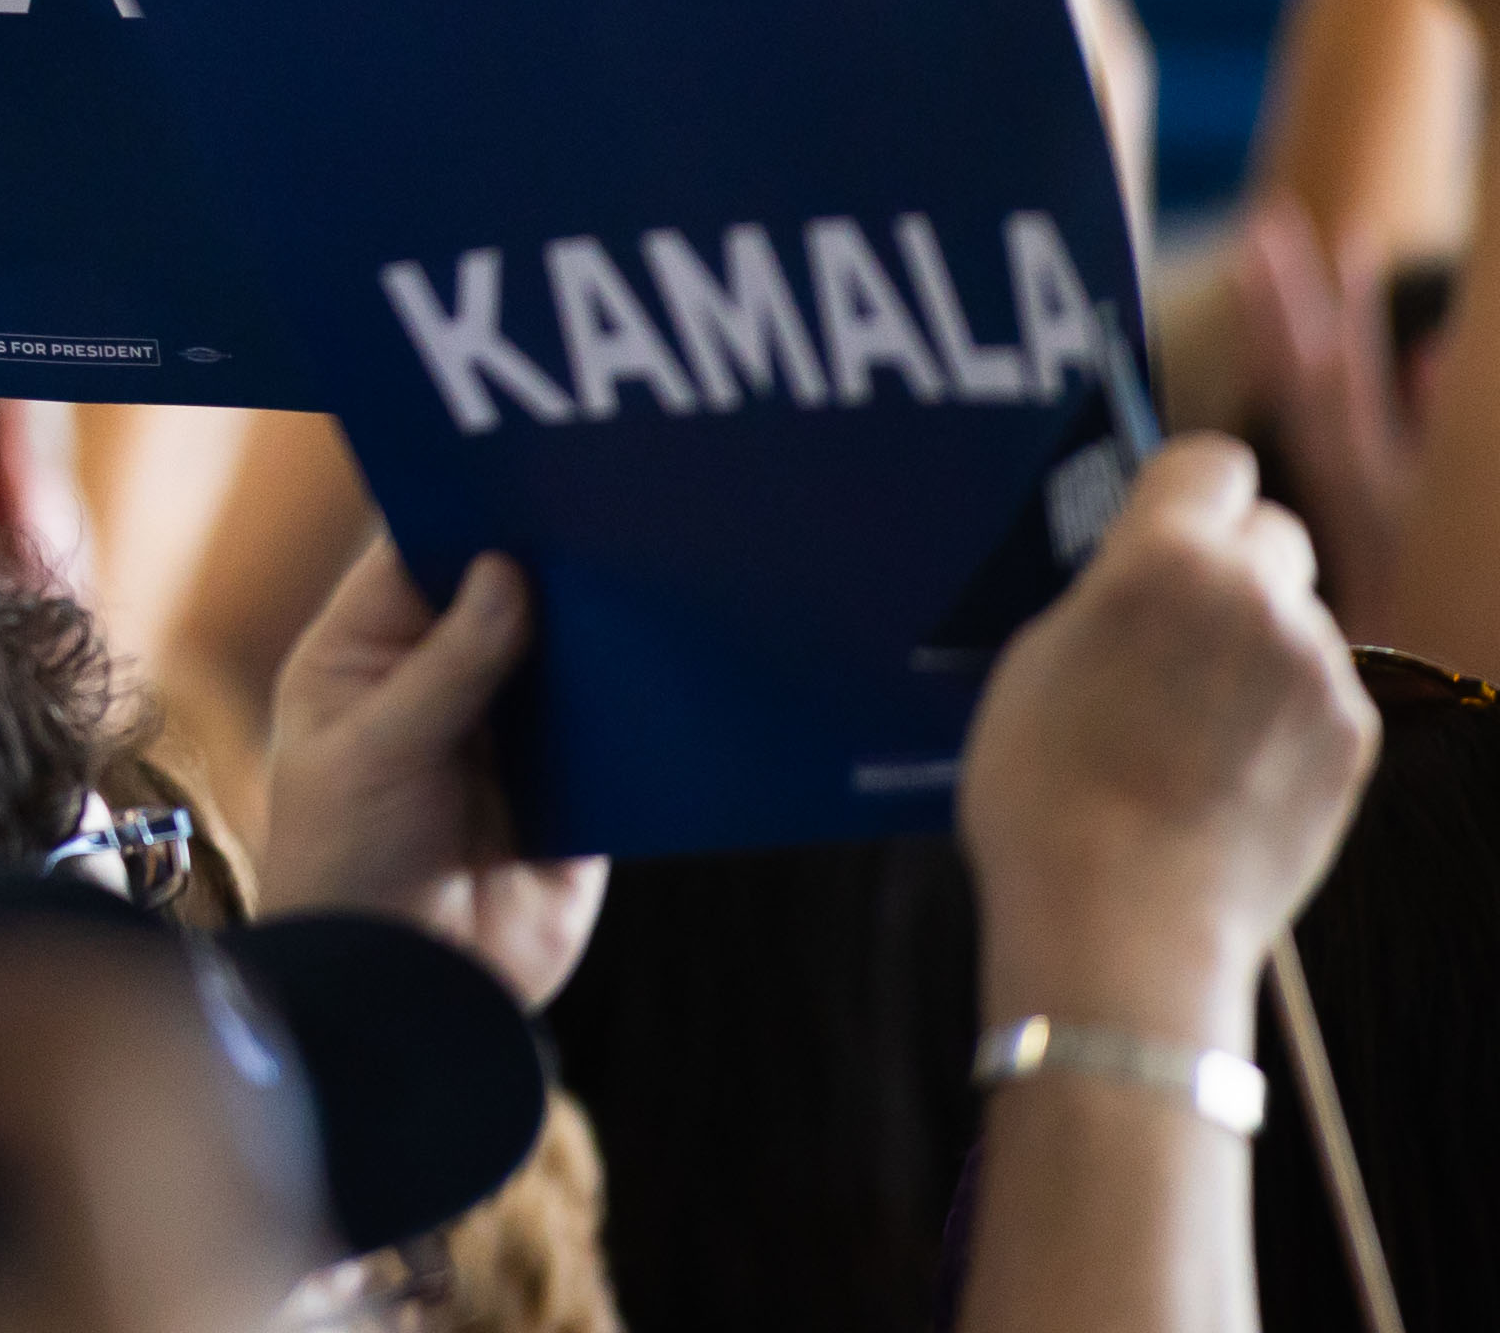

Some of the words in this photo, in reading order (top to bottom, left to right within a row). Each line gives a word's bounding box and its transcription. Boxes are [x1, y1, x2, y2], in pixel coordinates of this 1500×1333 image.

[11, 341, 46, 355] FOR
[51, 343, 153, 359] PRESIDENT
[380, 209, 1108, 435] KAMALA
